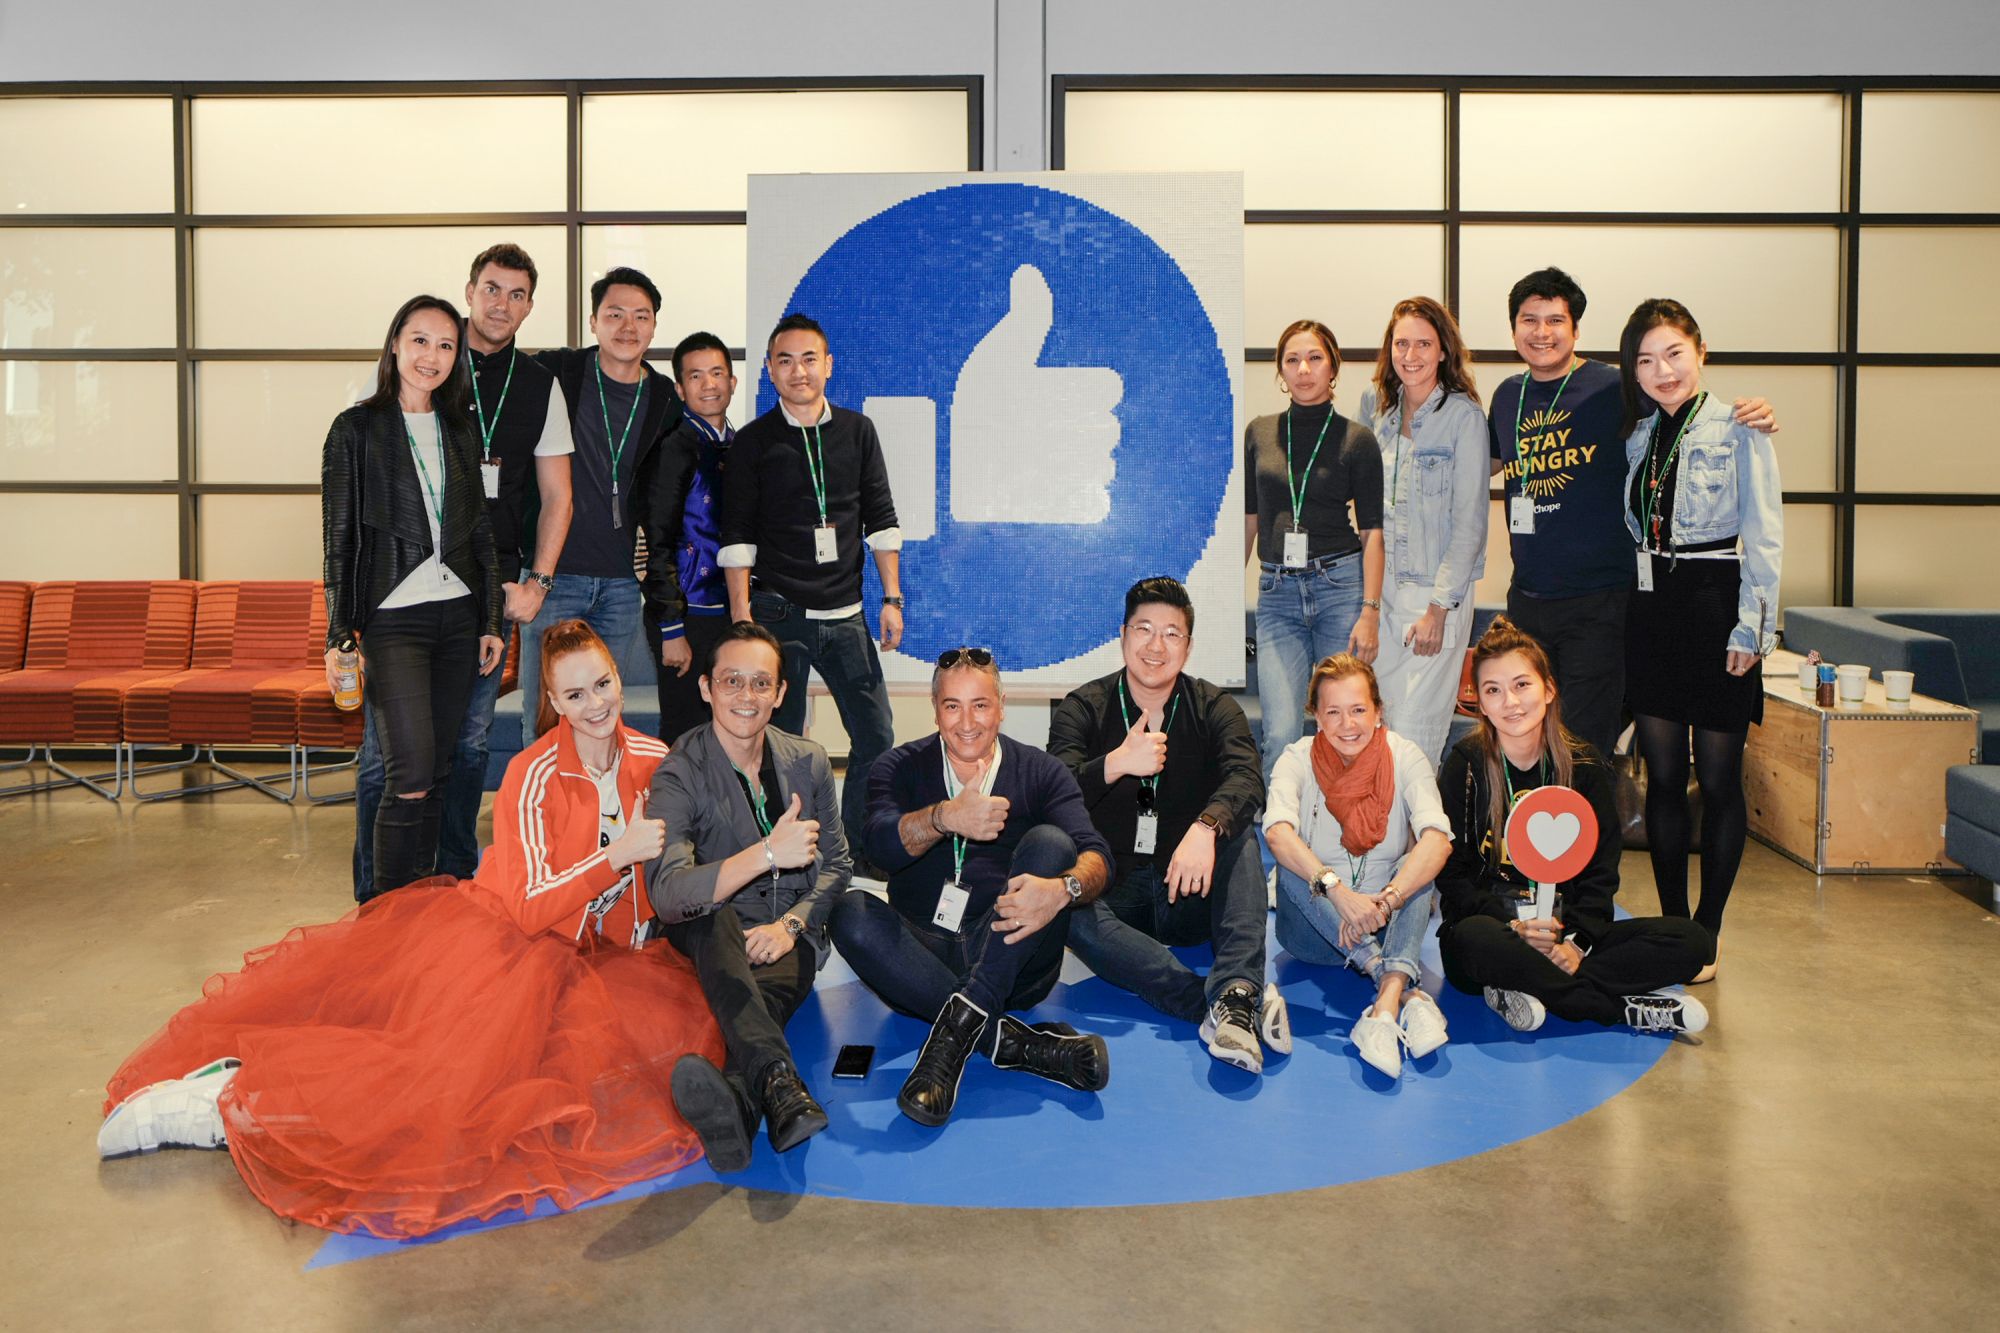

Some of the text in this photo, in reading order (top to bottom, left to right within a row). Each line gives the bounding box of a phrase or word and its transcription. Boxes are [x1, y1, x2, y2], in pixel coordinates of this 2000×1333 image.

[1519, 428, 1572, 456] STAY
[1504, 444, 1597, 481] HUNGRY
[1533, 502, 1561, 514] Chope
